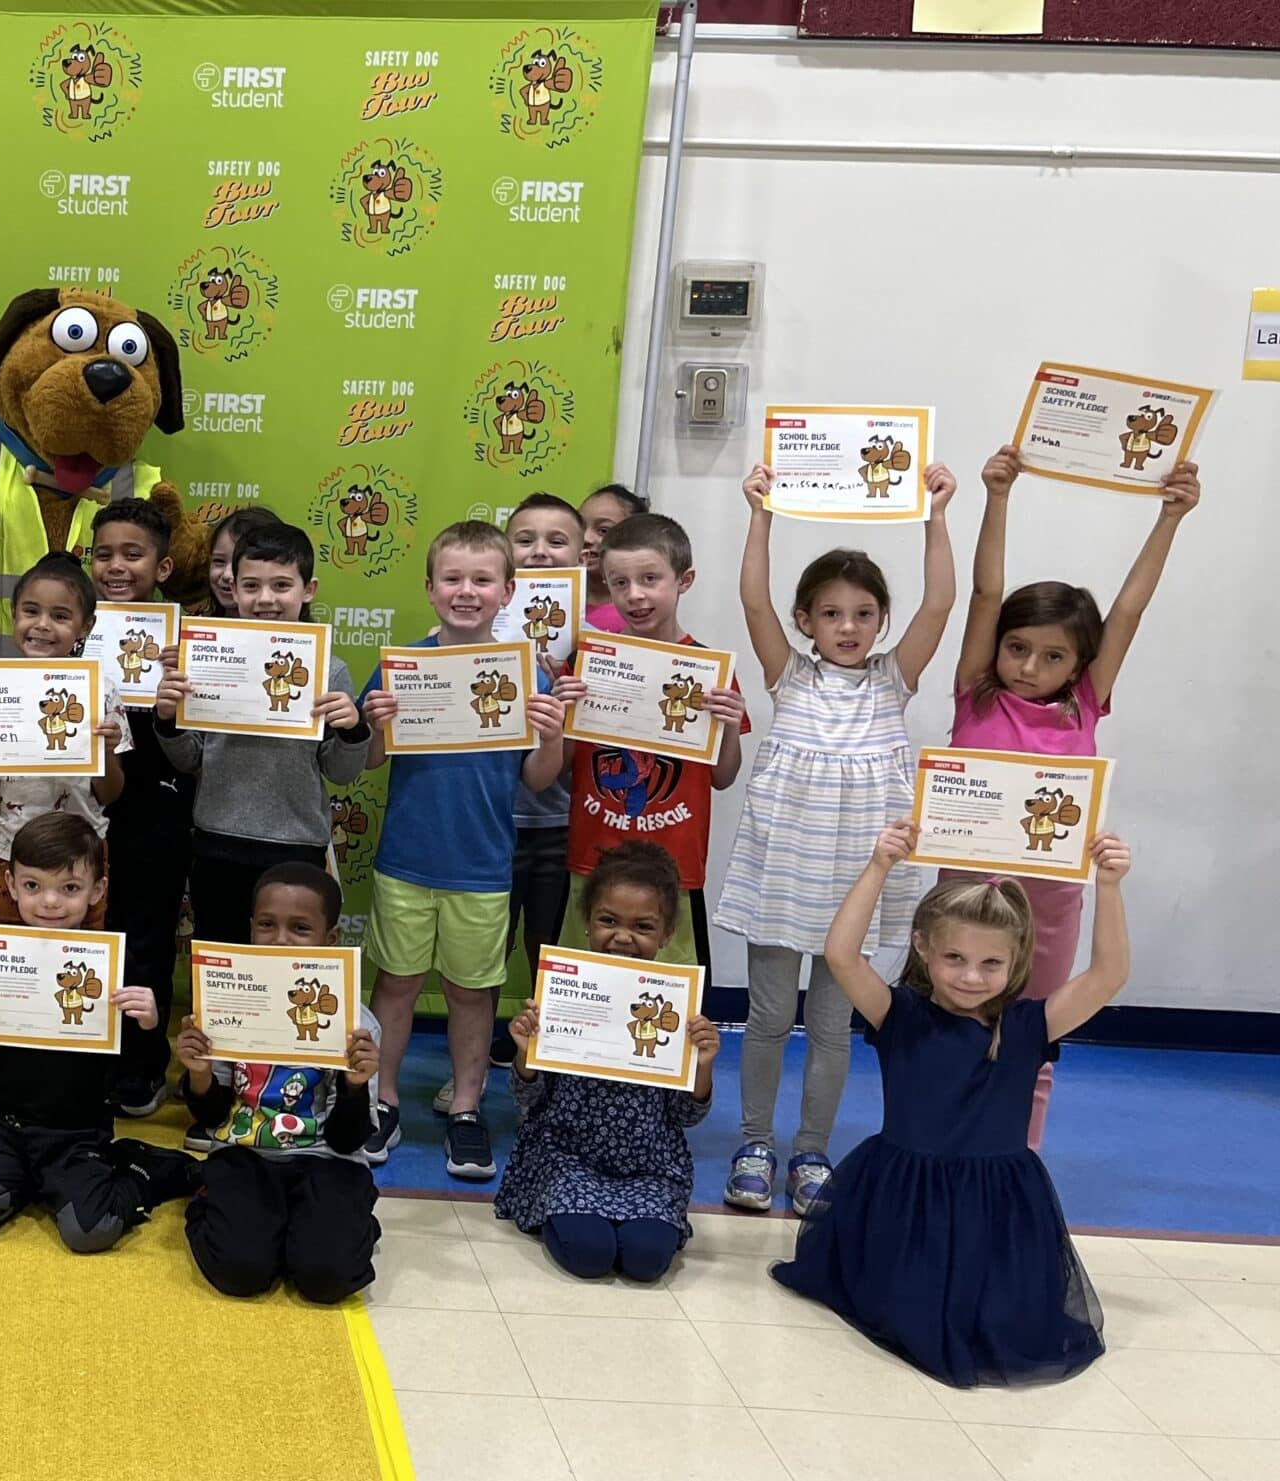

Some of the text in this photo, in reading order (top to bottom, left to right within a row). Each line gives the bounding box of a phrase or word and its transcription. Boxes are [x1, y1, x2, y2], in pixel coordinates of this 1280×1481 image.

[365, 50, 438, 67] SAFETY DOG
[222, 66, 286, 89] FIRST
[369, 70, 430, 96] Bus
[211, 88, 285, 108] student
[360, 88, 440, 120] Tour
[208, 161, 281, 177] SAFETY DOG
[68, 174, 130, 197] FIRST
[211, 178, 272, 204] Bus
[521, 181, 583, 203] FIRST
[57, 194, 128, 216] student
[203, 196, 280, 229] Tour
[509, 202, 580, 223] student
[48, 266, 120, 283] SAFETY DOG
[494, 274, 567, 291] SAFETY DOG
[355, 288, 418, 310] FIRST
[497, 292, 558, 318] Bus
[344, 309, 415, 330] student
[488, 310, 566, 343] Tour
[1257, 329, 1280, 345] La
[343, 379, 414, 395] SAFETY DOG
[1045, 387, 1096, 400] SCHOOL BUS
[203, 392, 265, 415] FIRST
[347, 398, 407, 422] Bus
[1042, 396, 1109, 413] SAFETY PLEDGE
[192, 414, 263, 433] student
[338, 416, 413, 447] Tour
[189, 482, 259, 497] SAFETY DOG
[333, 607, 394, 630] FIRST
[330, 627, 392, 648] tudent
[192, 645, 219, 653] SCHOOL
[192, 654, 247, 664] SAFETY PLEDGE
[590, 657, 633, 670] SCHOOL BUS
[395, 673, 421, 681] SCHOOL
[588, 666, 646, 681] SAFETY PLEDGE
[933, 774, 987, 787] SCHOOL BUS
[932, 785, 1002, 800] SAFETY PLEDGE
[583, 794, 693, 832] TO THE RESCUE
[11, 966, 38, 974] PLEDGE
[206, 971, 253, 981] SCHOOL BUS
[206, 981, 268, 992] SAFETY PLEDGE
[551, 977, 597, 990] SCHOOL BUS
[549, 987, 611, 1003] SAFETY PLEDGE
